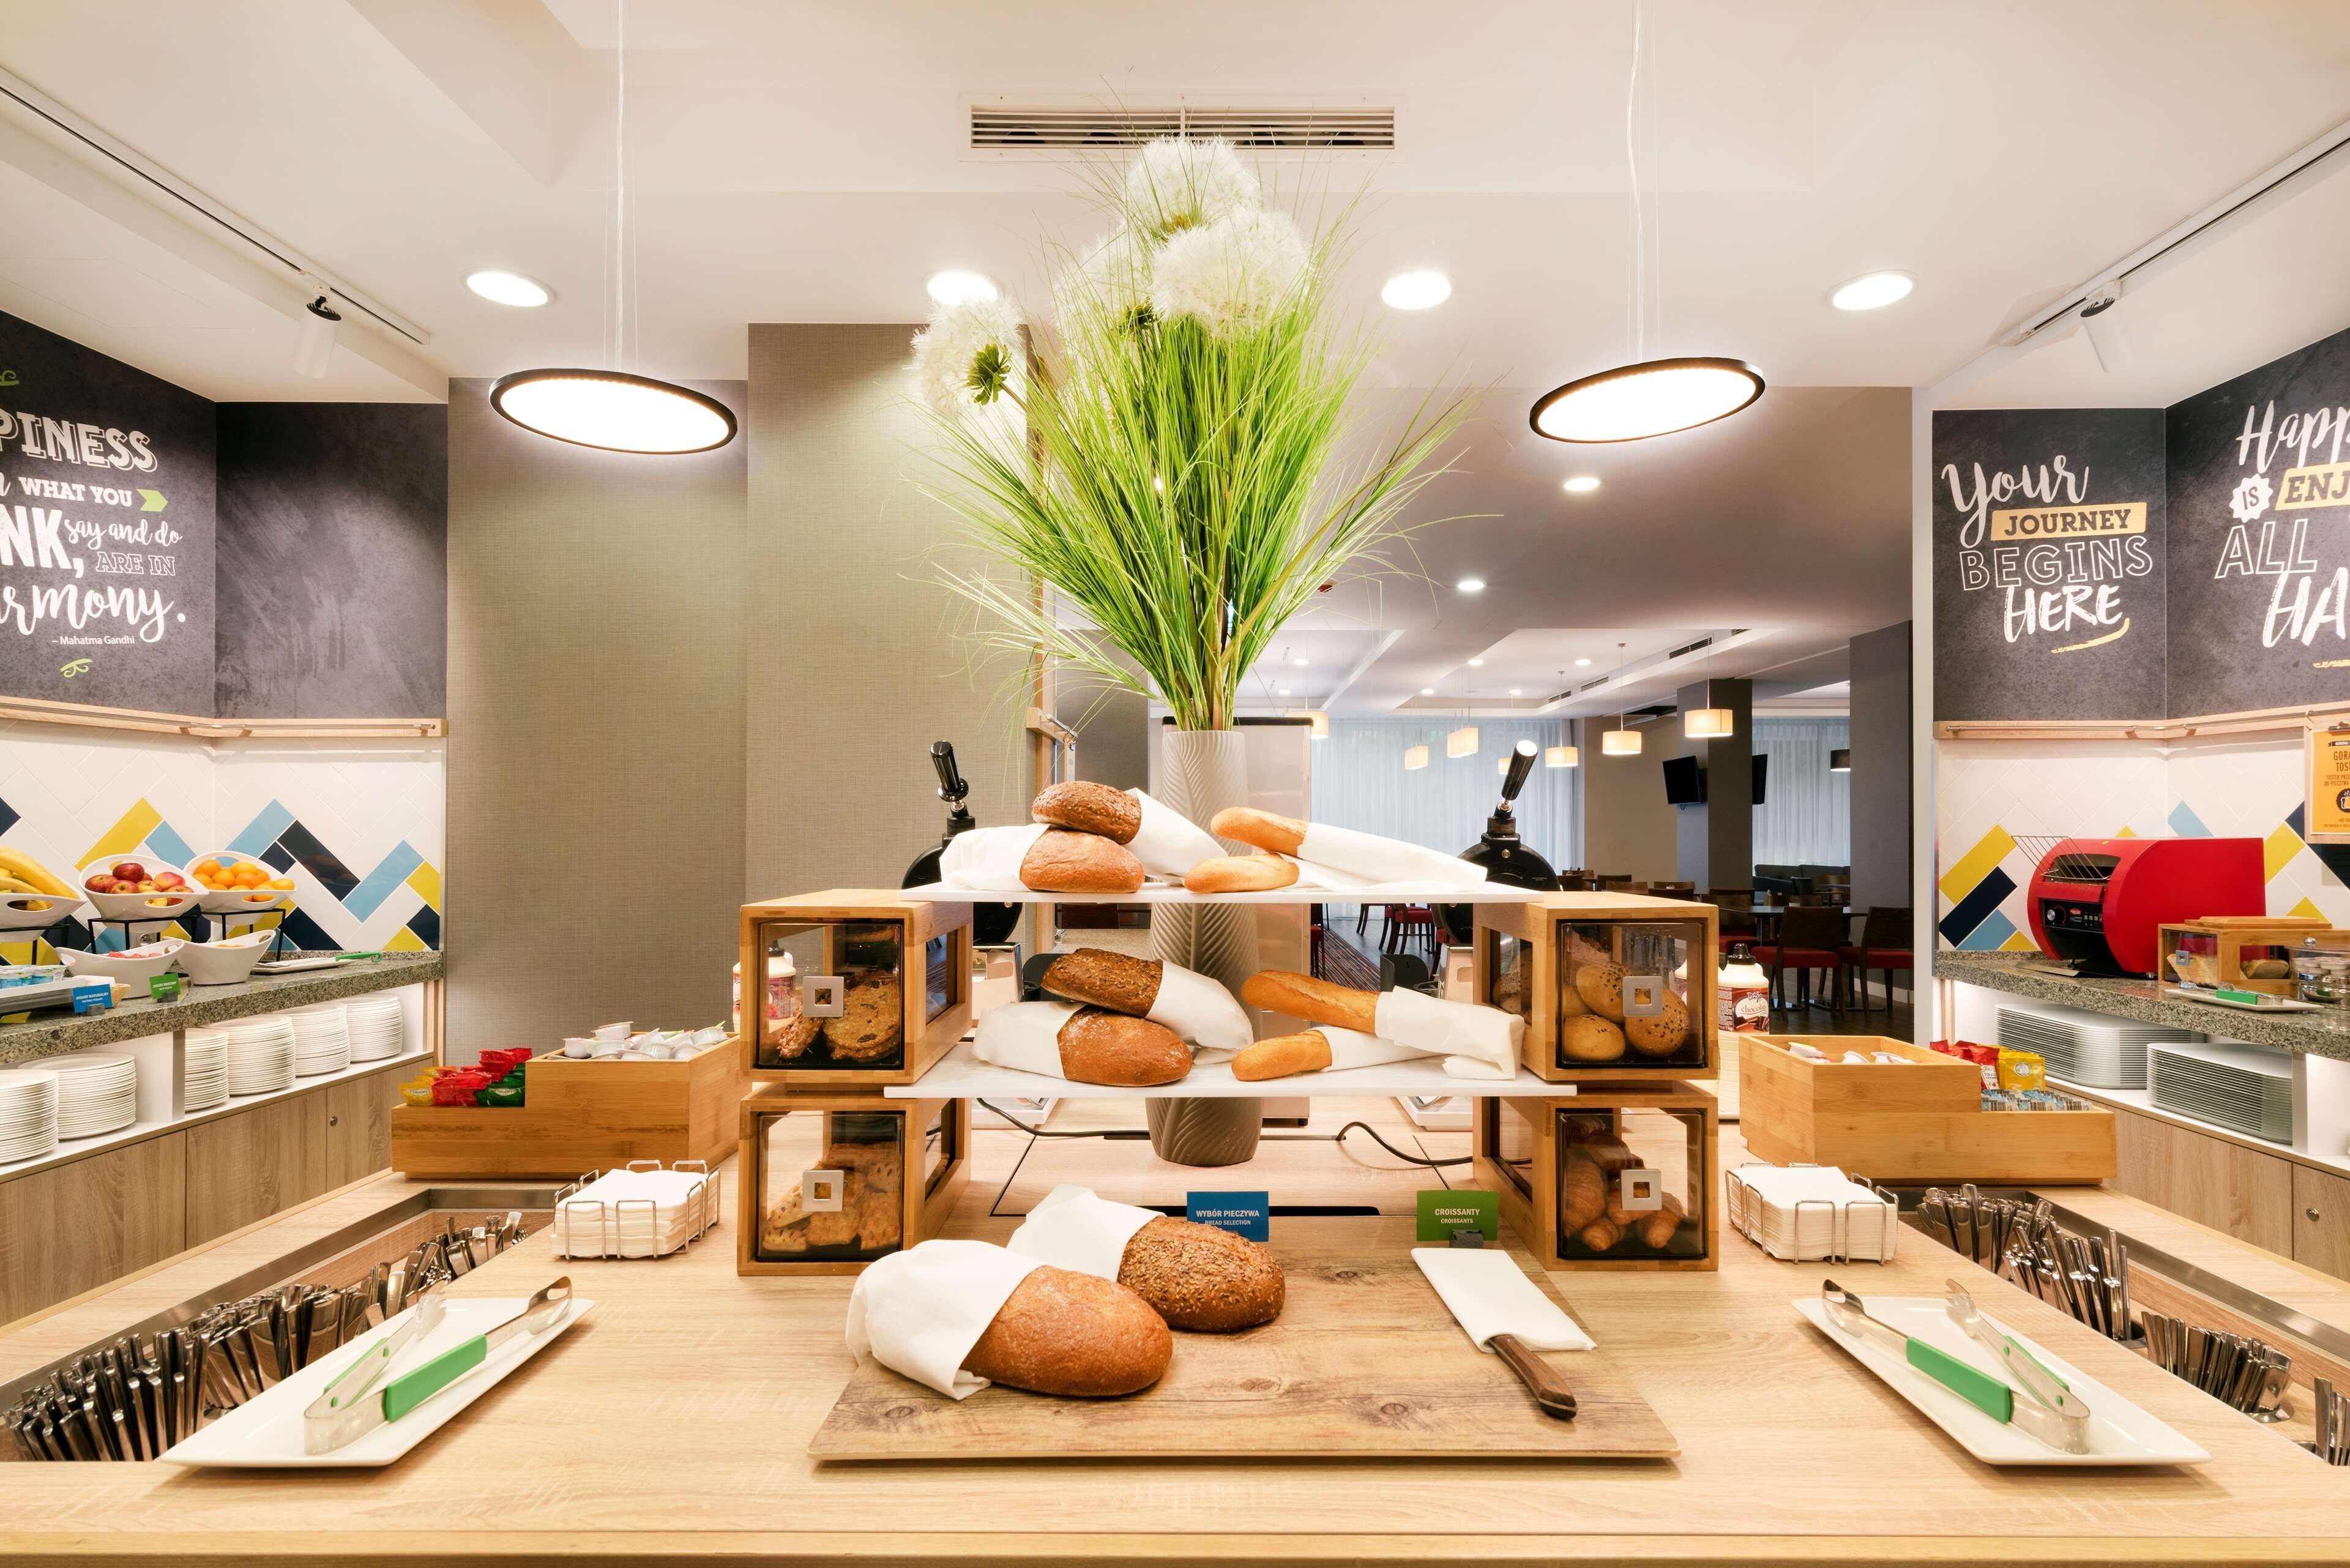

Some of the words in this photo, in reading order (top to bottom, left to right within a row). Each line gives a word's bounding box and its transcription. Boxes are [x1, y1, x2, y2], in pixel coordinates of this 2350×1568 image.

[18, 477, 85, 501] WHAT
[89, 486, 132, 507] YOU
[1941, 455, 2089, 548] Your
[2242, 486, 2259, 510] IS
[64, 518, 106, 550] say
[108, 519, 152, 545] and
[155, 521, 183, 547] do
[2004, 509, 2131, 536] JOURNEY
[95, 551, 144, 574] ARE
[148, 554, 176, 576] IN
[1959, 536, 2152, 591] BEGINS
[2214, 518, 2318, 578] ALL
[0, 584, 186, 643] rmony.
[2004, 584, 2122, 643] HERE
[2262, 567, 2348, 648] HA
[60, 636, 102, 644] Mahatma
[104, 635, 135, 644] Gandhi
